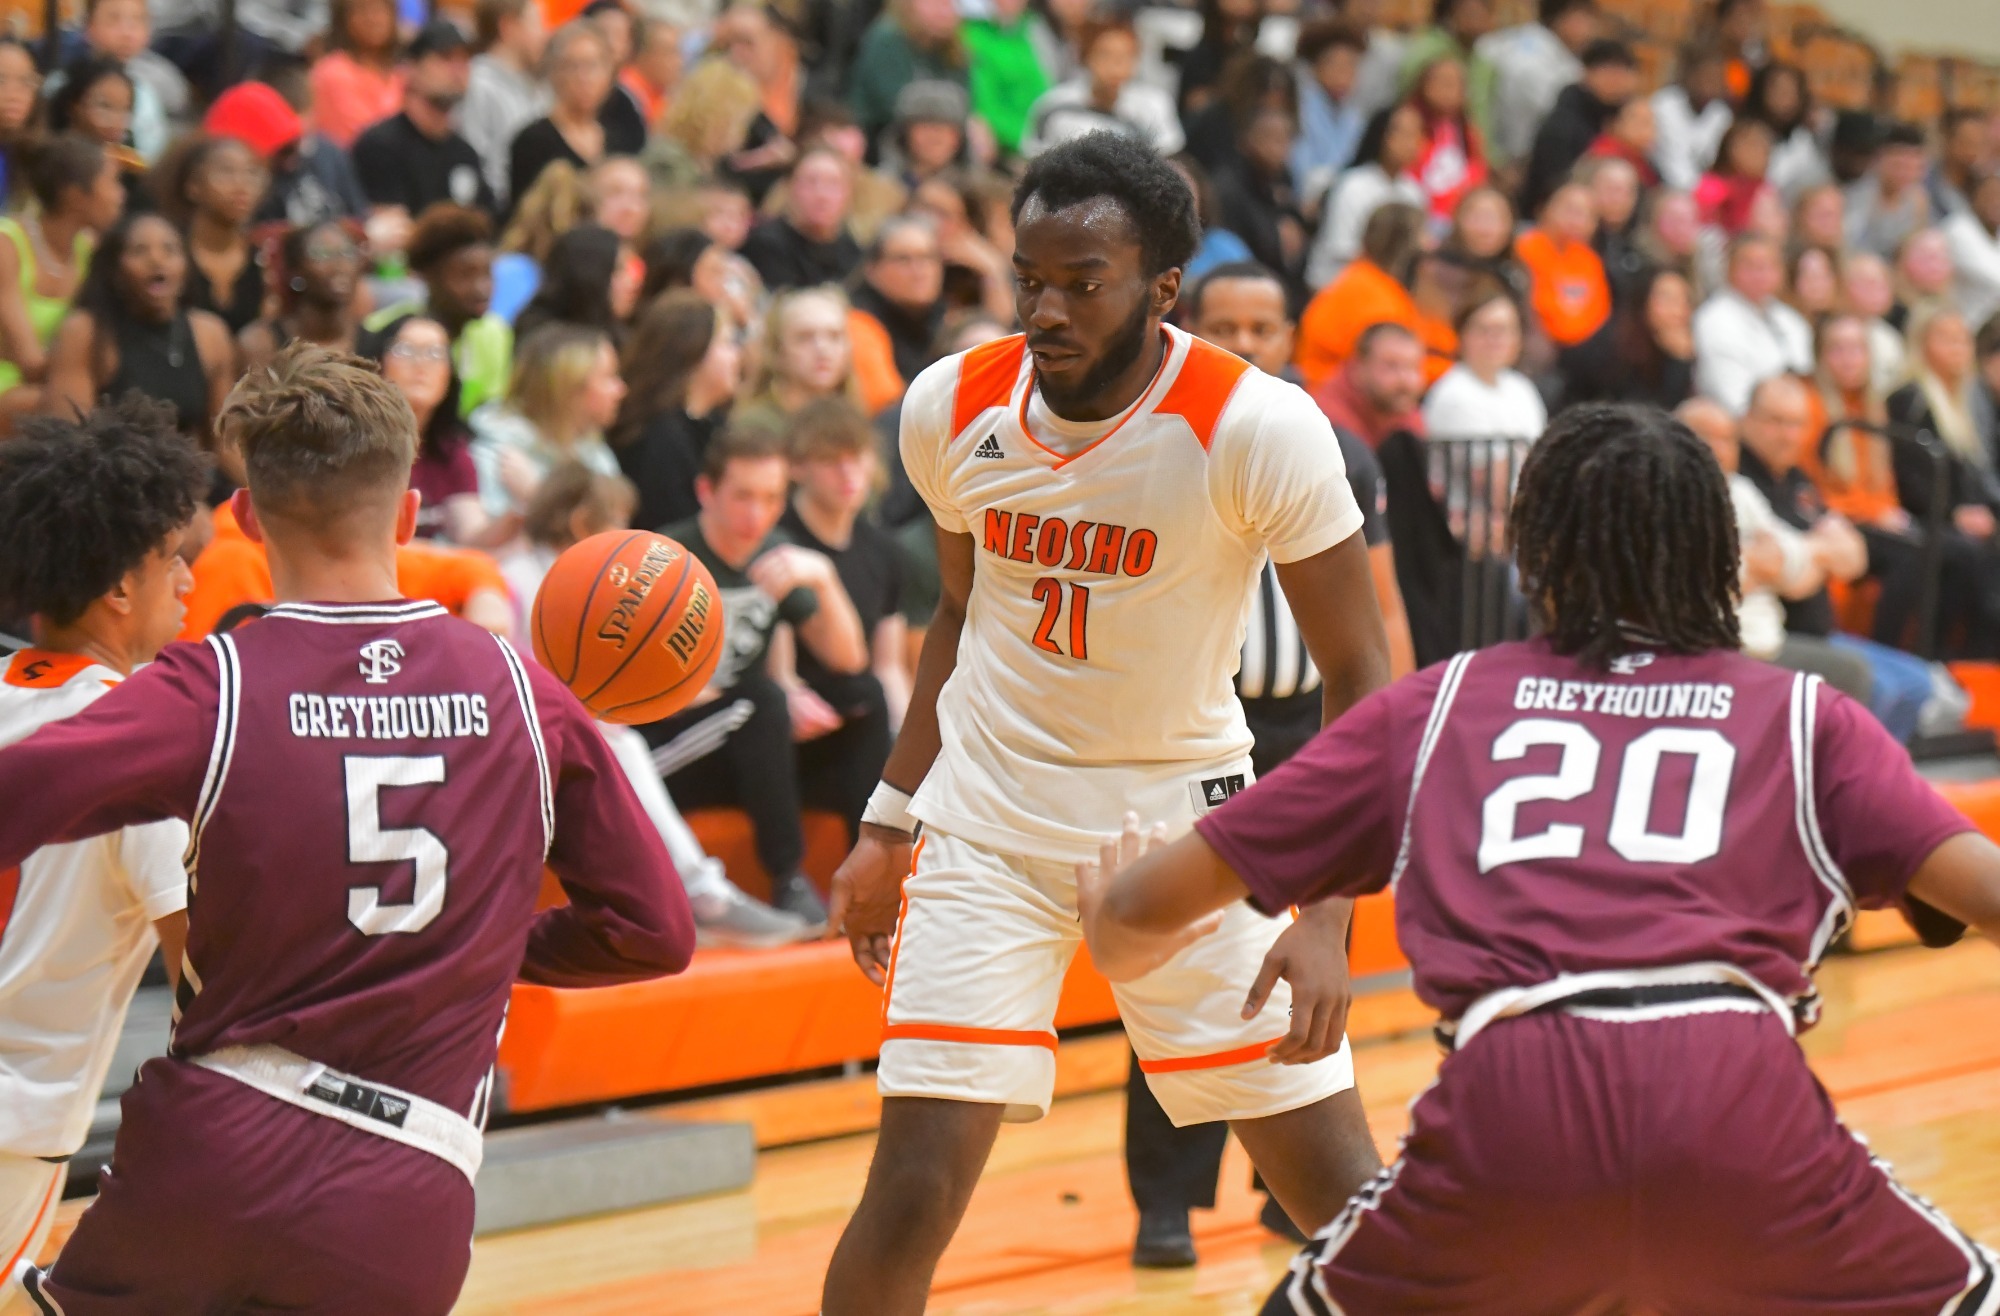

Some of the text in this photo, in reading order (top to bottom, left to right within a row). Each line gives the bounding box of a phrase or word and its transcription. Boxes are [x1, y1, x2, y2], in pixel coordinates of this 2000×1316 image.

[975, 449, 1005, 459] adidas
[983, 508, 1158, 577] NEOSHO
[597, 540, 682, 650] SPALDING
[1031, 577, 1090, 660] 21
[289, 692, 490, 739] GREYHOUNDS
[1514, 676, 1734, 719] GREYHOUNDS
[1478, 717, 1736, 875] 20
[344, 755, 448, 936] 5
